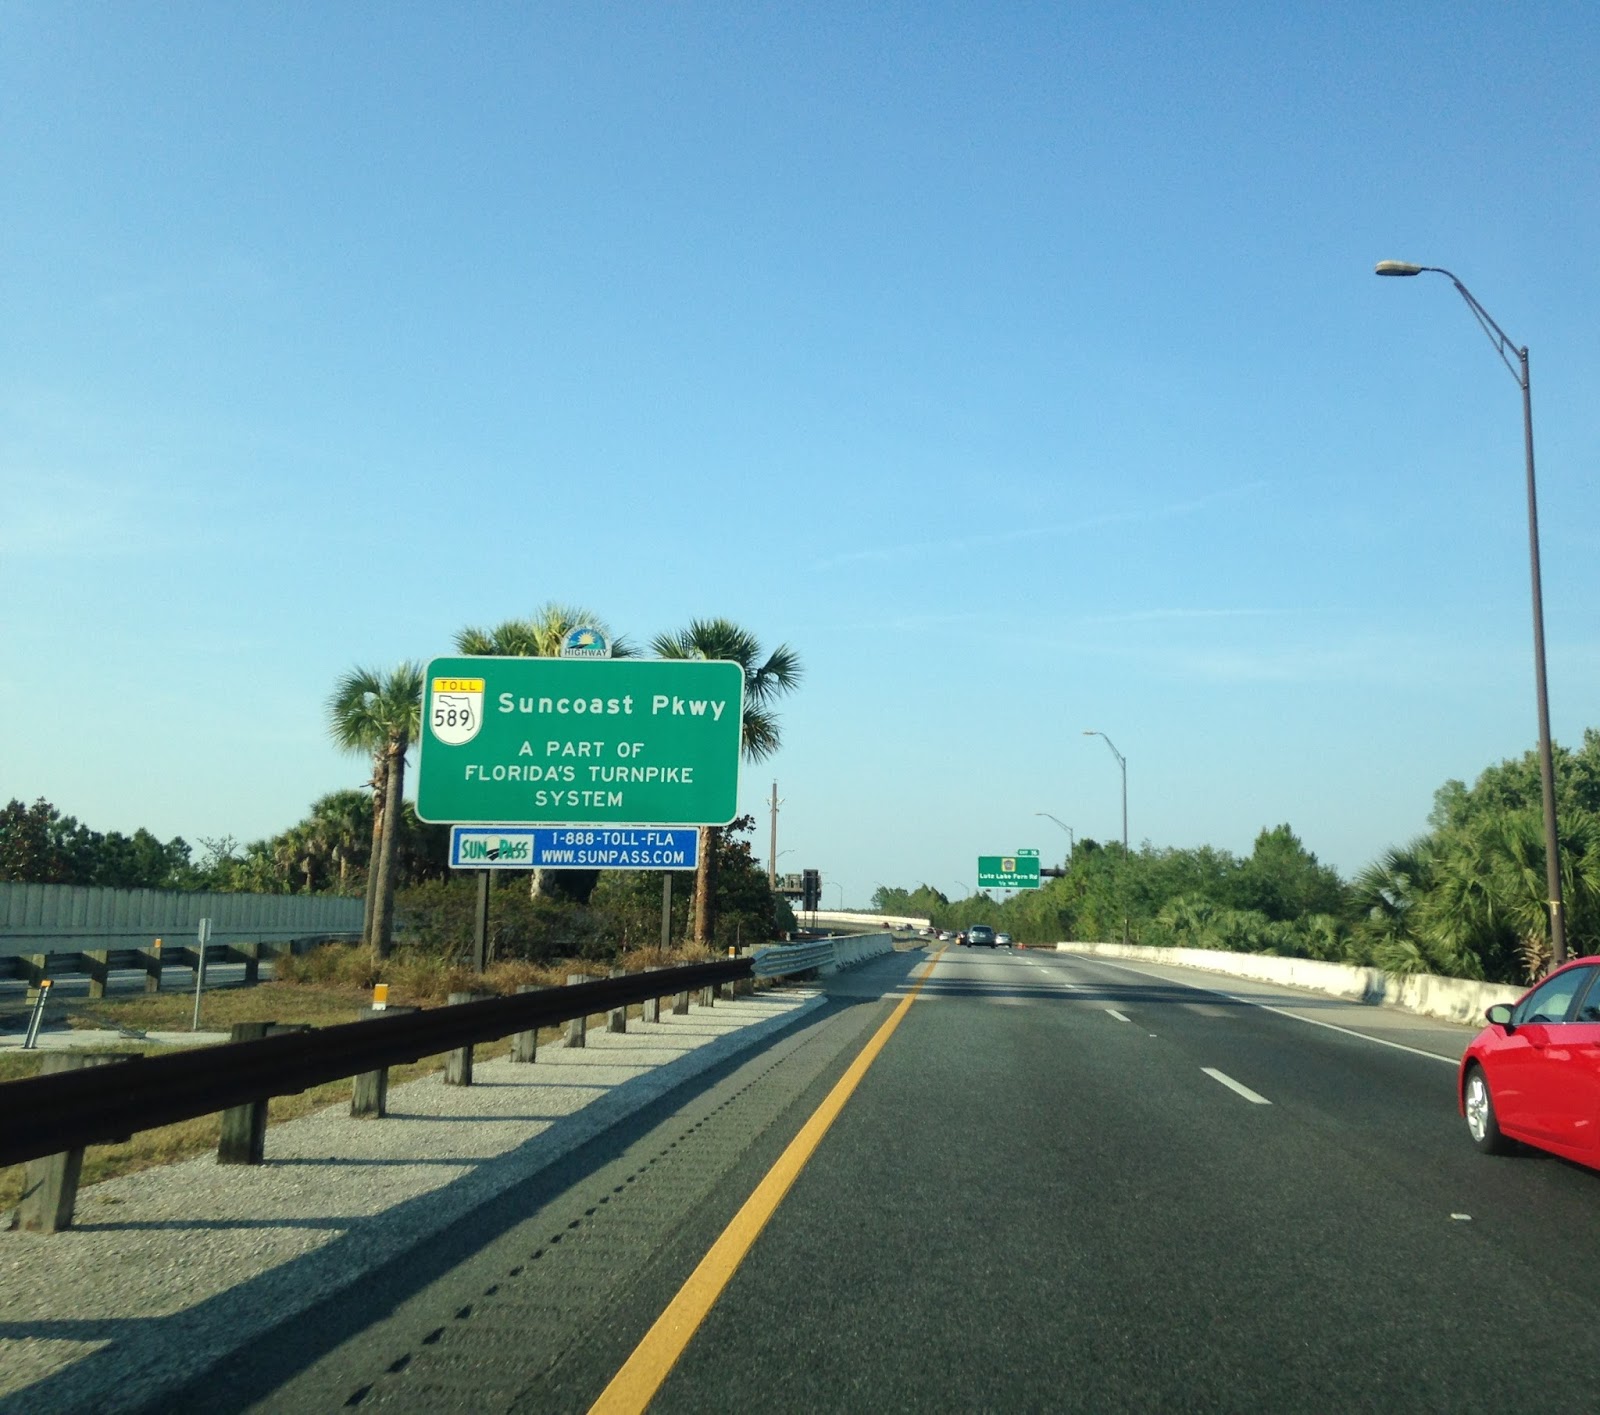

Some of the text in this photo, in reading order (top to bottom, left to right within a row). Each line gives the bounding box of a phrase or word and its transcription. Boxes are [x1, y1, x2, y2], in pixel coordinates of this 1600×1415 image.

[440, 680, 476, 691] TOLL
[498, 692, 726, 721] Suncoast Pkwy
[434, 709, 469, 727] 589
[519, 741, 645, 758] A PART OF
[465, 765, 693, 783] FLORIDA'S TURNPIKE
[535, 790, 623, 807] SYSTEM
[552, 832, 674, 846] 1-888-TOLL-FLA
[541, 850, 684, 864] WWW.SUNPASS.COM
